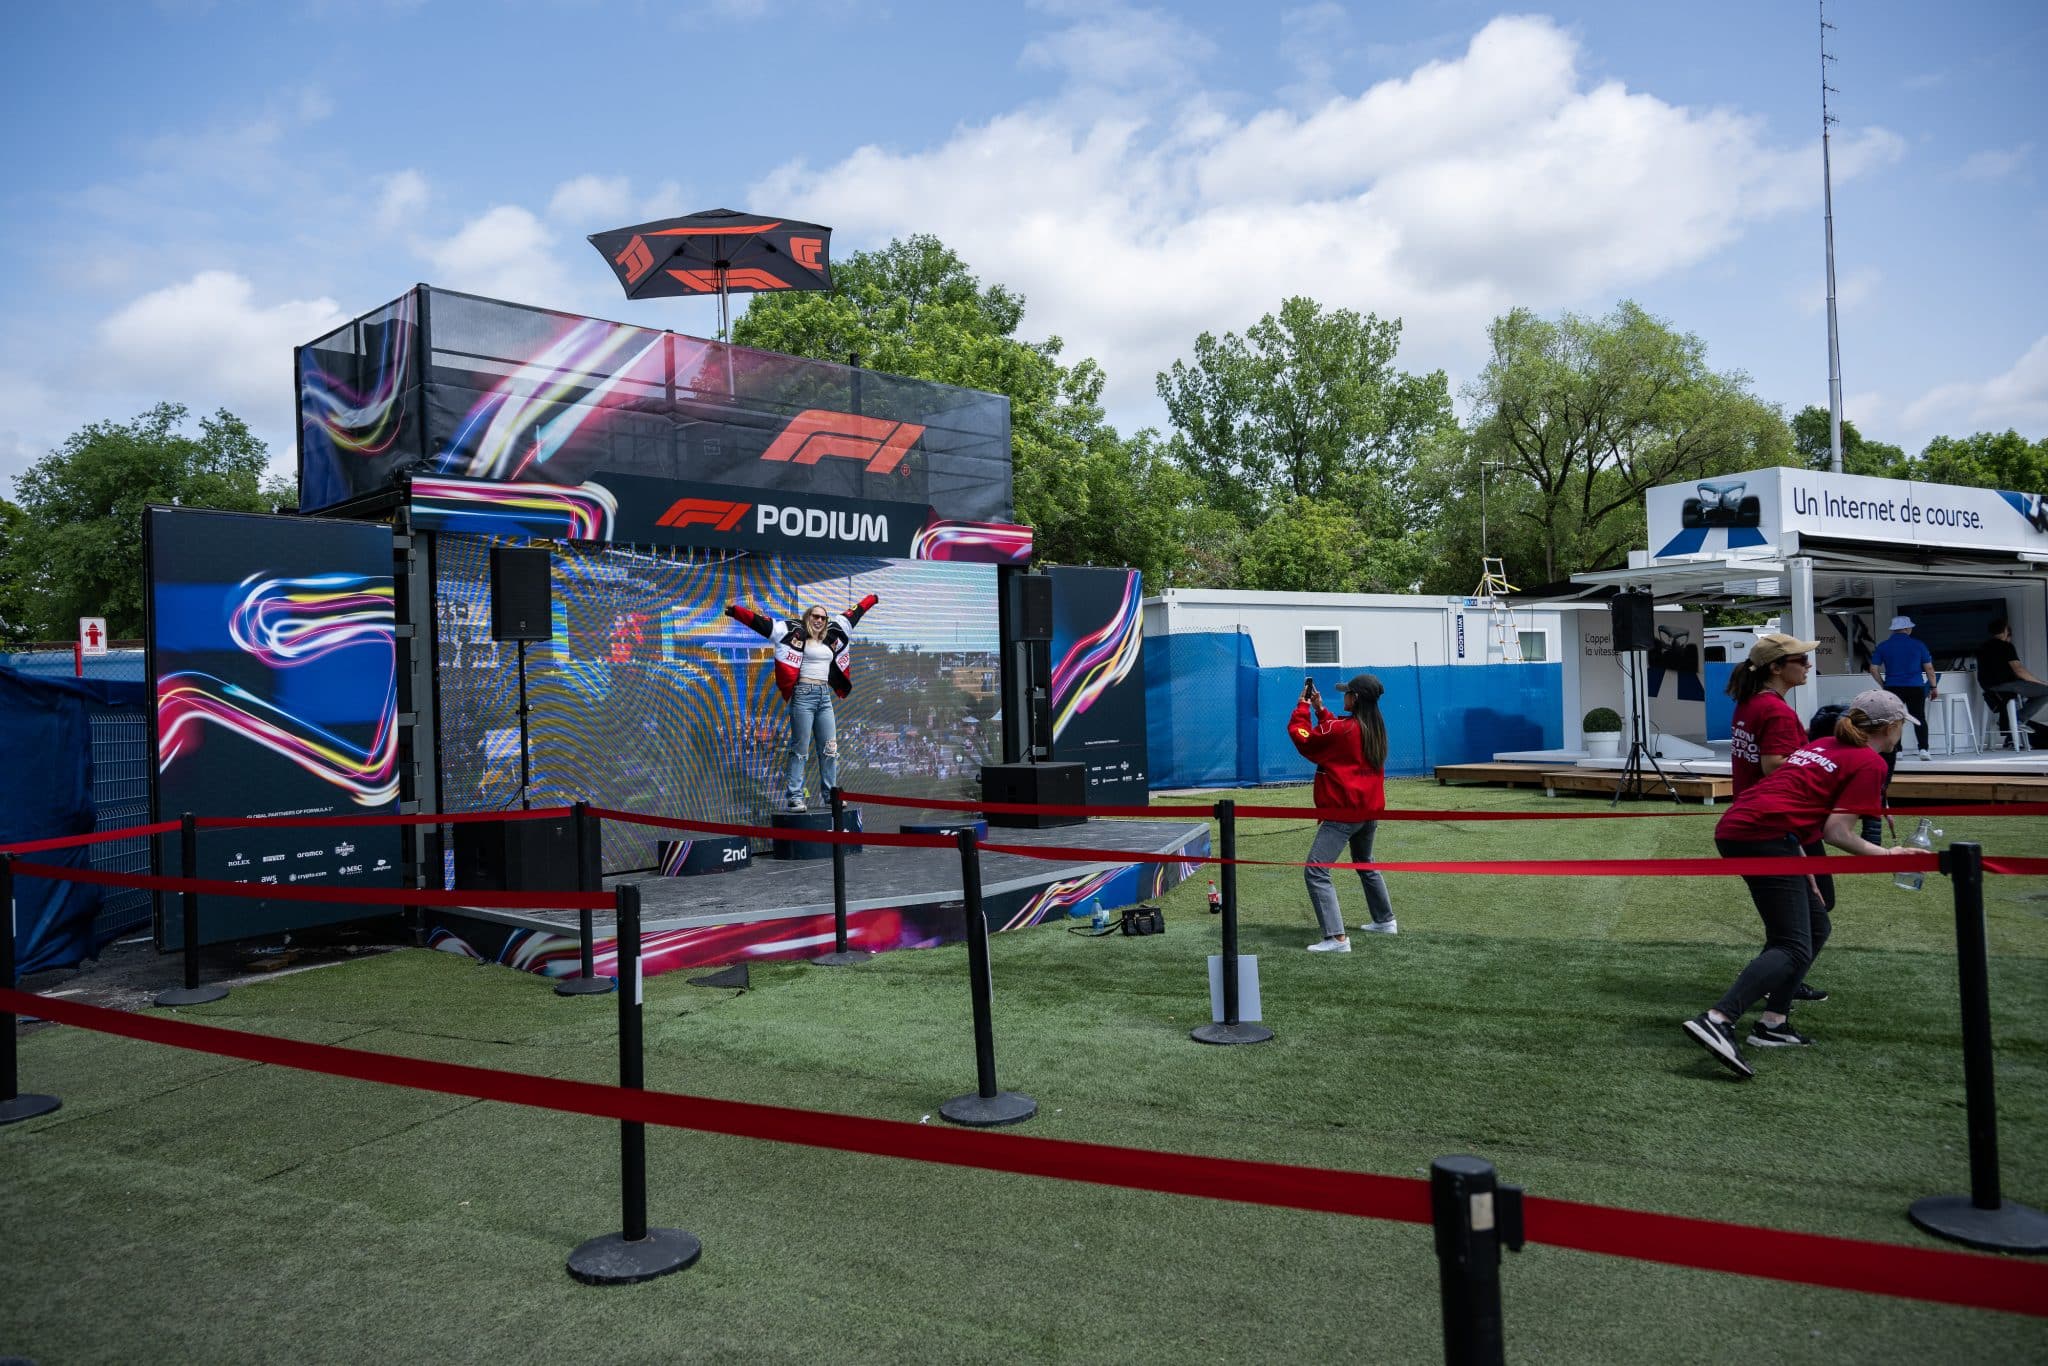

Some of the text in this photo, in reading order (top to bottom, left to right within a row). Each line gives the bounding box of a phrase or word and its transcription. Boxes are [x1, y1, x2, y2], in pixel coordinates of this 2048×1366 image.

[760, 408, 927, 474] F1
[1793, 487, 1984, 529] Un Internet de course.
[655, 497, 889, 543] F1 PODIUM
[1585, 632, 1611, 645] L'appel
[1585, 646, 1592, 656] la
[228, 859, 250, 867] ROLEX
[297, 850, 323, 858] aramco
[723, 845, 747, 862] 2nd
[261, 875, 277, 884] aws
[297, 871, 327, 881] crypto.com
